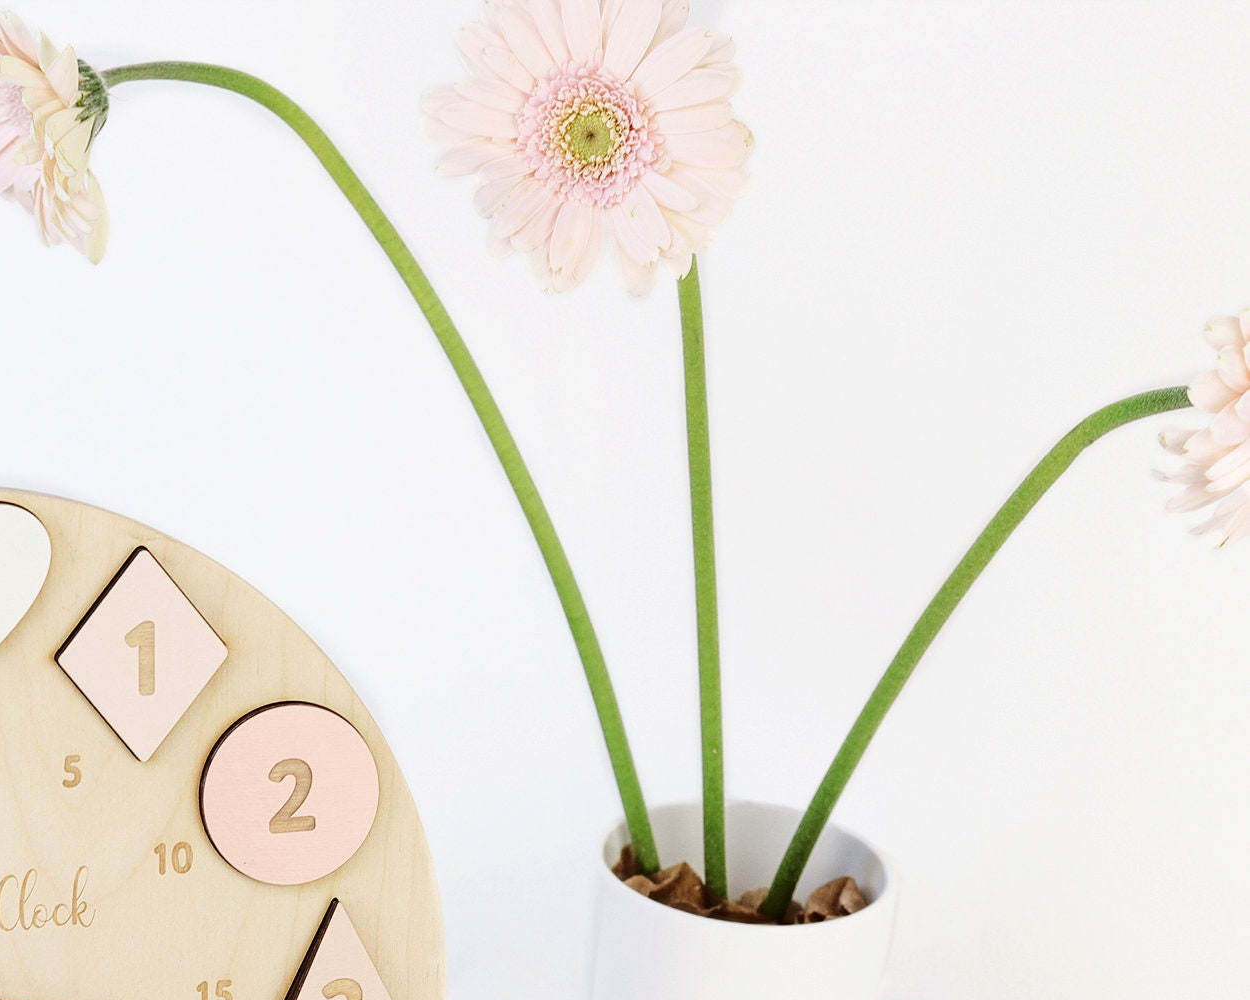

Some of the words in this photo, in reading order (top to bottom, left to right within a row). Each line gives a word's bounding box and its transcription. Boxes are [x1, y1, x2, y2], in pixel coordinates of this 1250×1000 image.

[124, 621, 155, 696] 1
[62, 755, 81, 788] 5
[268, 758, 316, 834] 2
[154, 841, 193, 875] 10
